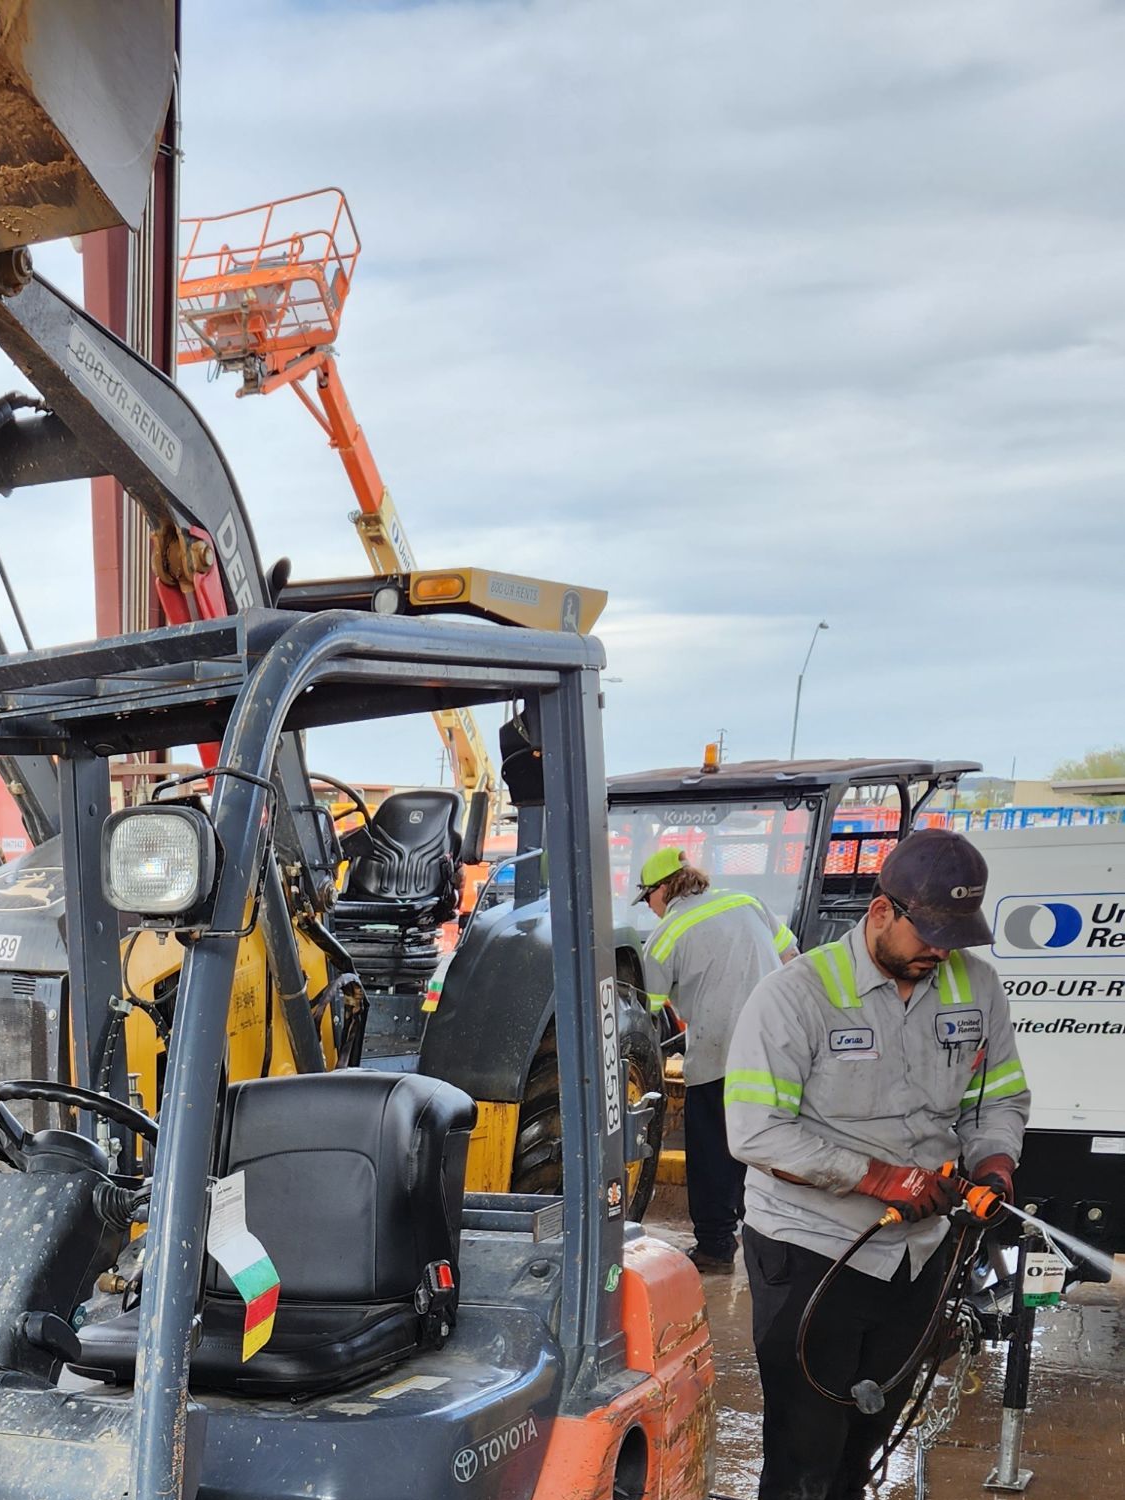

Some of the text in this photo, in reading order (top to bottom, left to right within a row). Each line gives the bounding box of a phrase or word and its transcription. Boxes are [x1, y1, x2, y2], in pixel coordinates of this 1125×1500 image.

[75, 342, 176, 461] 800-UR-RENTS
[491, 580, 539, 601] 800-UR-RENTS
[663, 810, 718, 824] Kubota
[957, 1019, 980, 1027] United
[957, 1026, 981, 1034] Rentals
[837, 1034, 863, 1045] Jonas
[601, 984, 620, 1130] 50358
[478, 1417, 538, 1467] TOYOTA
